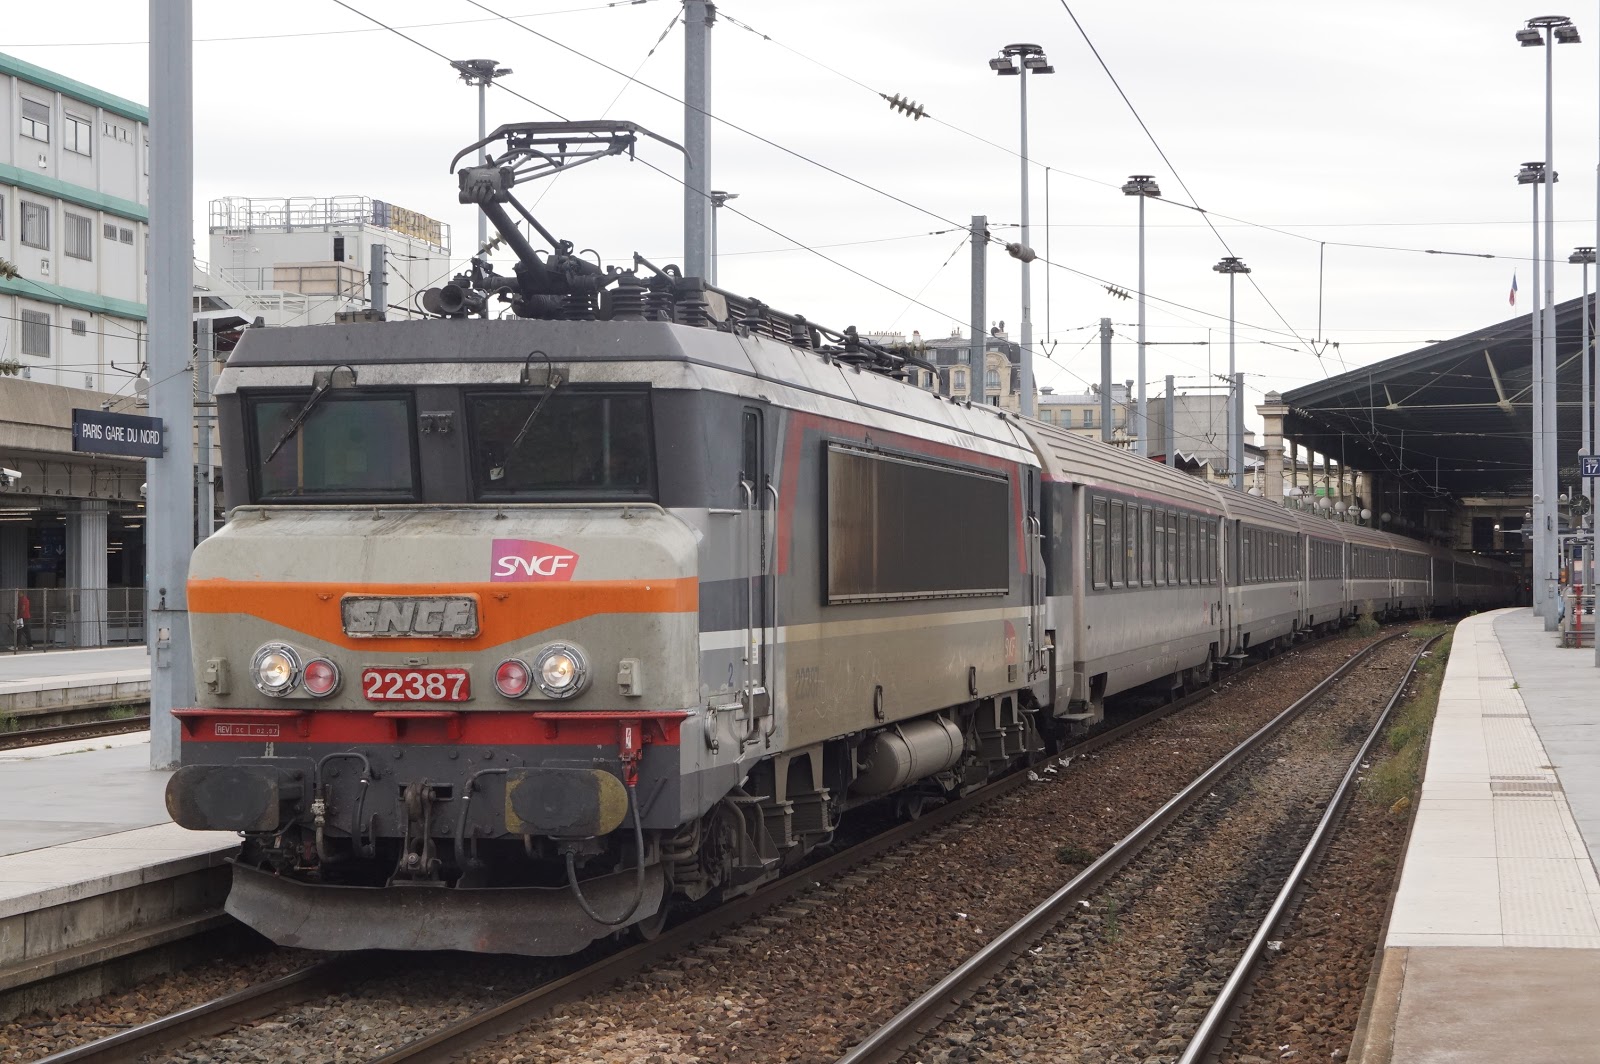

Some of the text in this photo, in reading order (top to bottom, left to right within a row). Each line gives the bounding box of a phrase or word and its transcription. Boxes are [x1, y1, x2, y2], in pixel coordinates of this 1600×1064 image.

[82, 423, 160, 445] PARIS GARE DU NORD
[1585, 463, 1598, 473] 17
[494, 555, 574, 577] SNCF
[348, 601, 470, 632] SNCF
[363, 672, 466, 700] 22387
[728, 662, 734, 688] 2
[217, 725, 230, 733] REV
